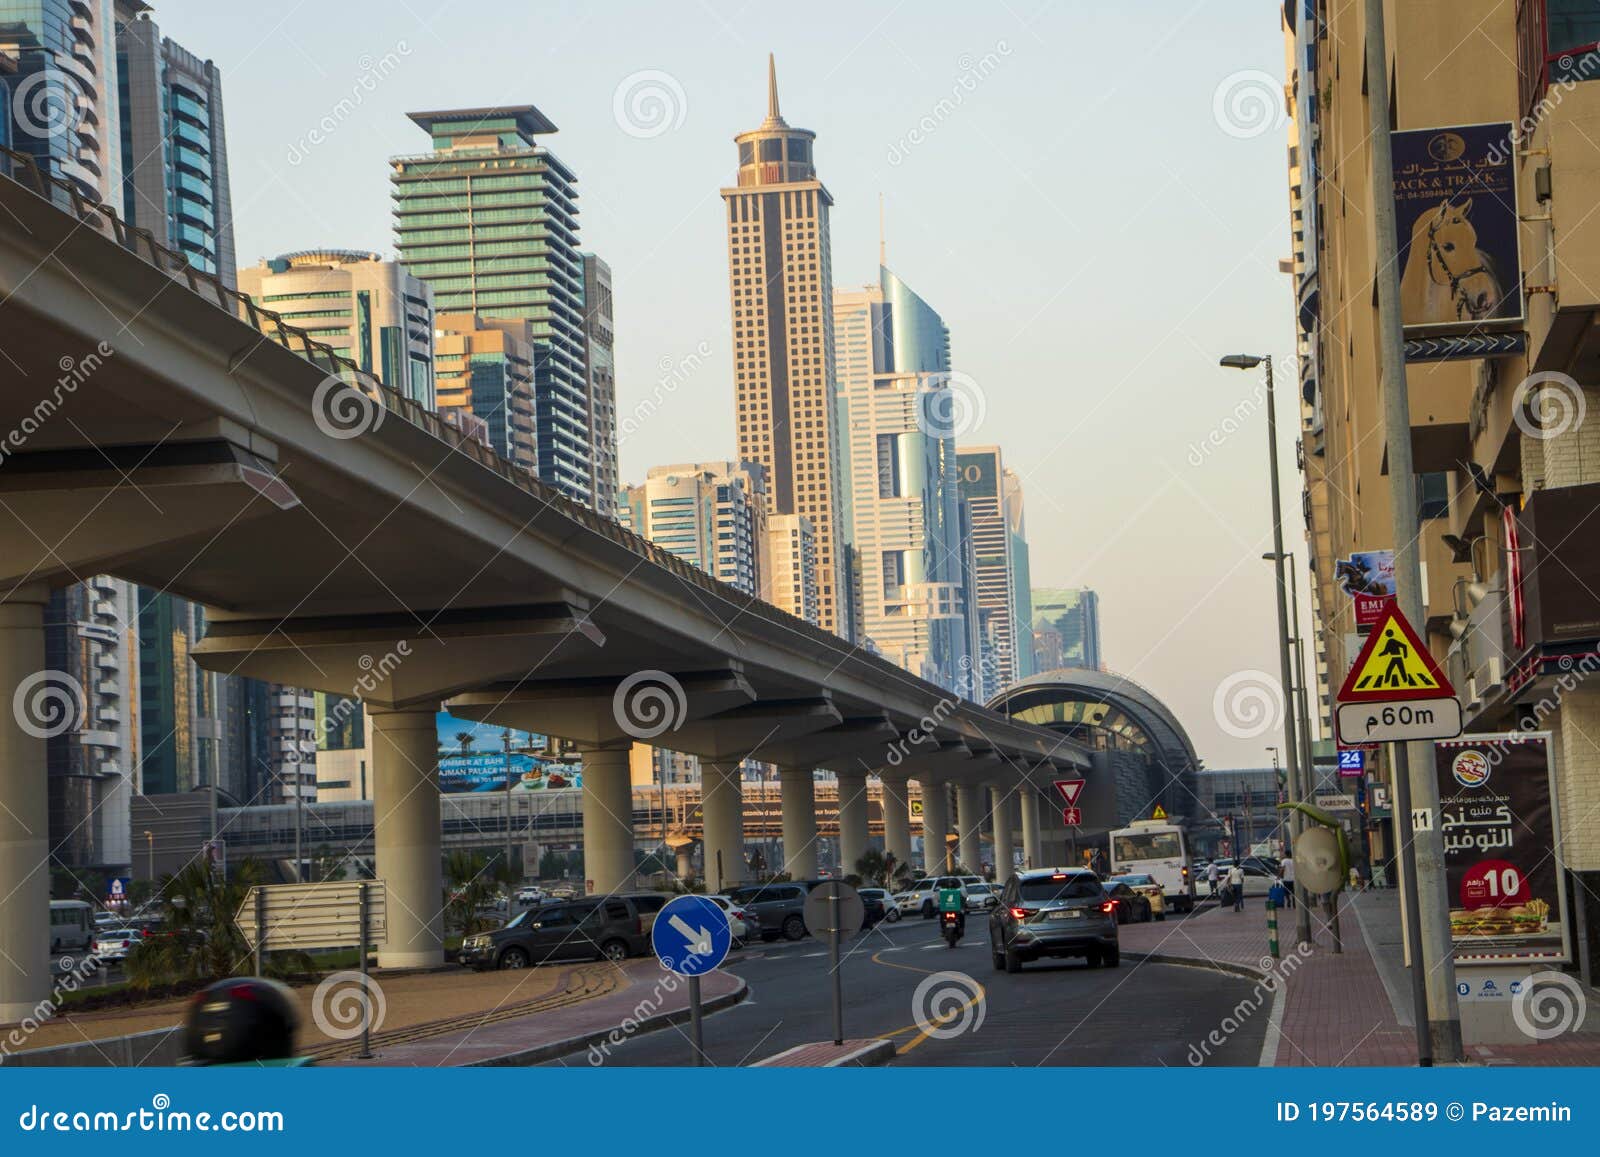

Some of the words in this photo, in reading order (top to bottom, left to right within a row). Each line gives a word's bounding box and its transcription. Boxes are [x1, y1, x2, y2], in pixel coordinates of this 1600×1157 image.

[1341, 752, 1361, 764] 24
[1413, 811, 1428, 829] 11
[1443, 828, 1513, 854] التوفير
[1484, 868, 1520, 896] 10
